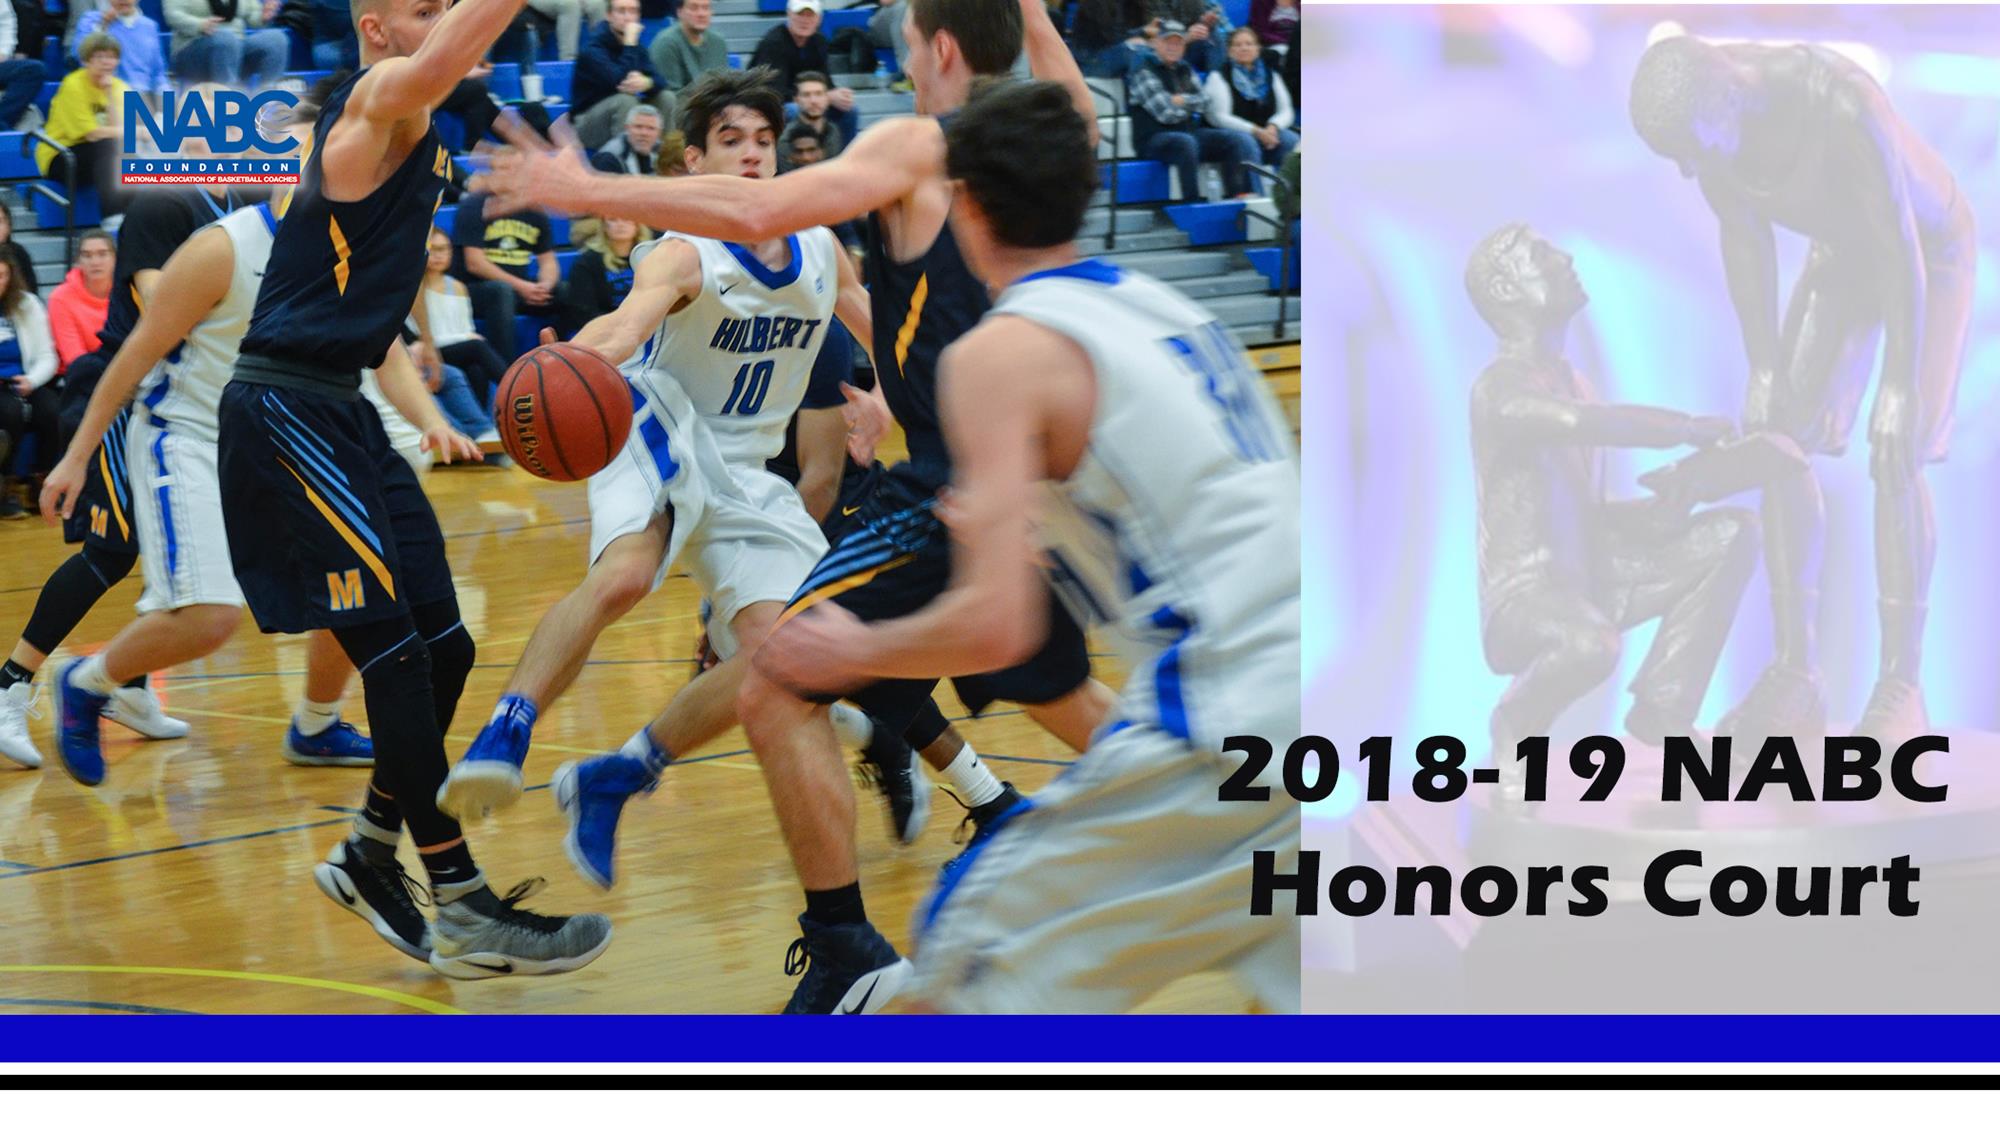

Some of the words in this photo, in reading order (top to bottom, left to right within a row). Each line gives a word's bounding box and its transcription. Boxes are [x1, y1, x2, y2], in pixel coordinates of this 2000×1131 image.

[709, 316, 821, 355] HILBERT
[720, 359, 775, 415] 10
[326, 568, 365, 611] M
